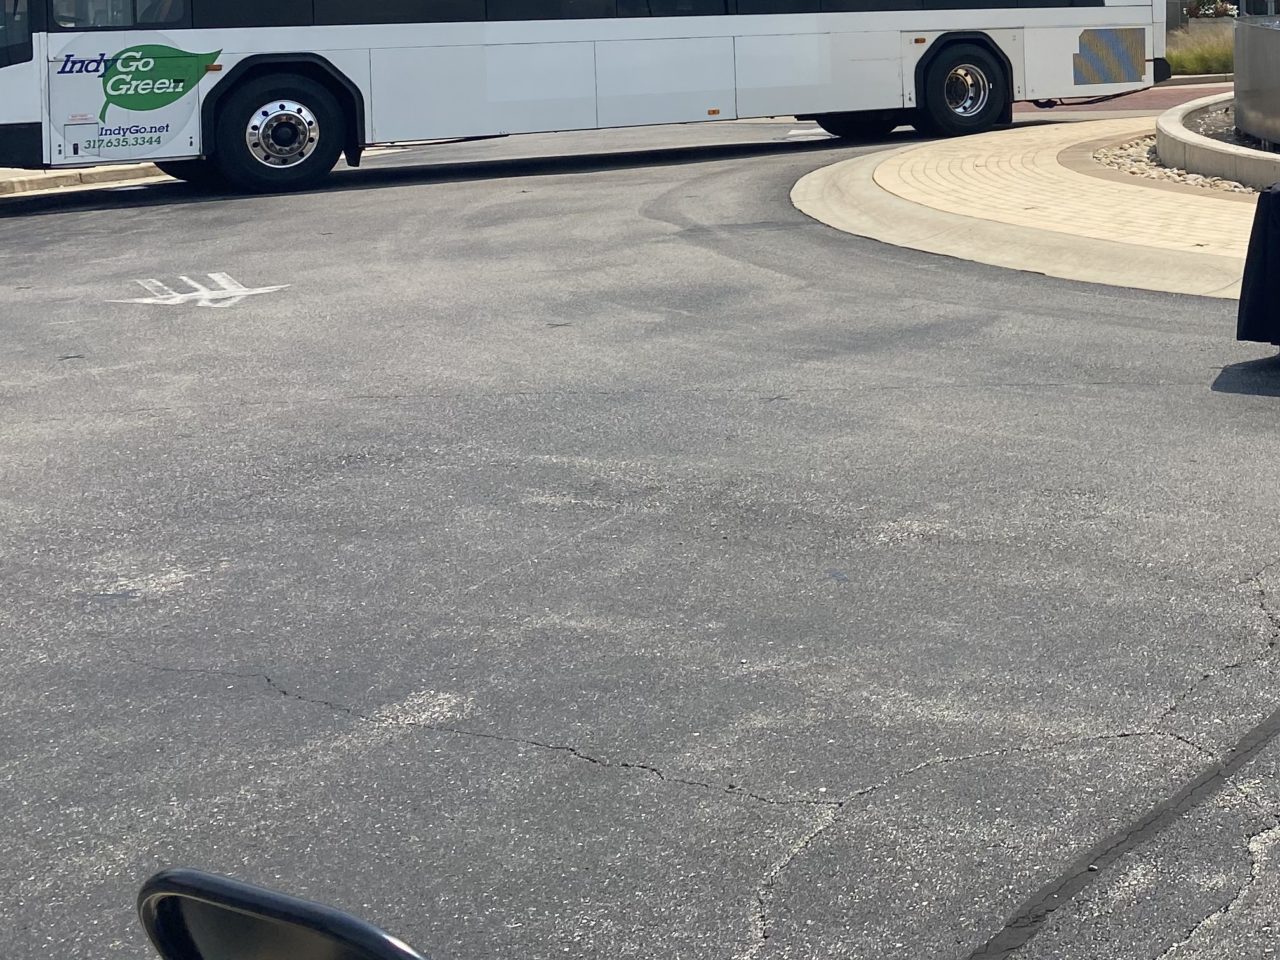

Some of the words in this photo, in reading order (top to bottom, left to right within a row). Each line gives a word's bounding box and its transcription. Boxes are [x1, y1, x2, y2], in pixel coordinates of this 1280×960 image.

[57, 51, 155, 78] IndyGo
[106, 74, 184, 96] Green
[98, 123, 170, 137] IndyGo.net
[84, 136, 162, 150] 317.635.3344
